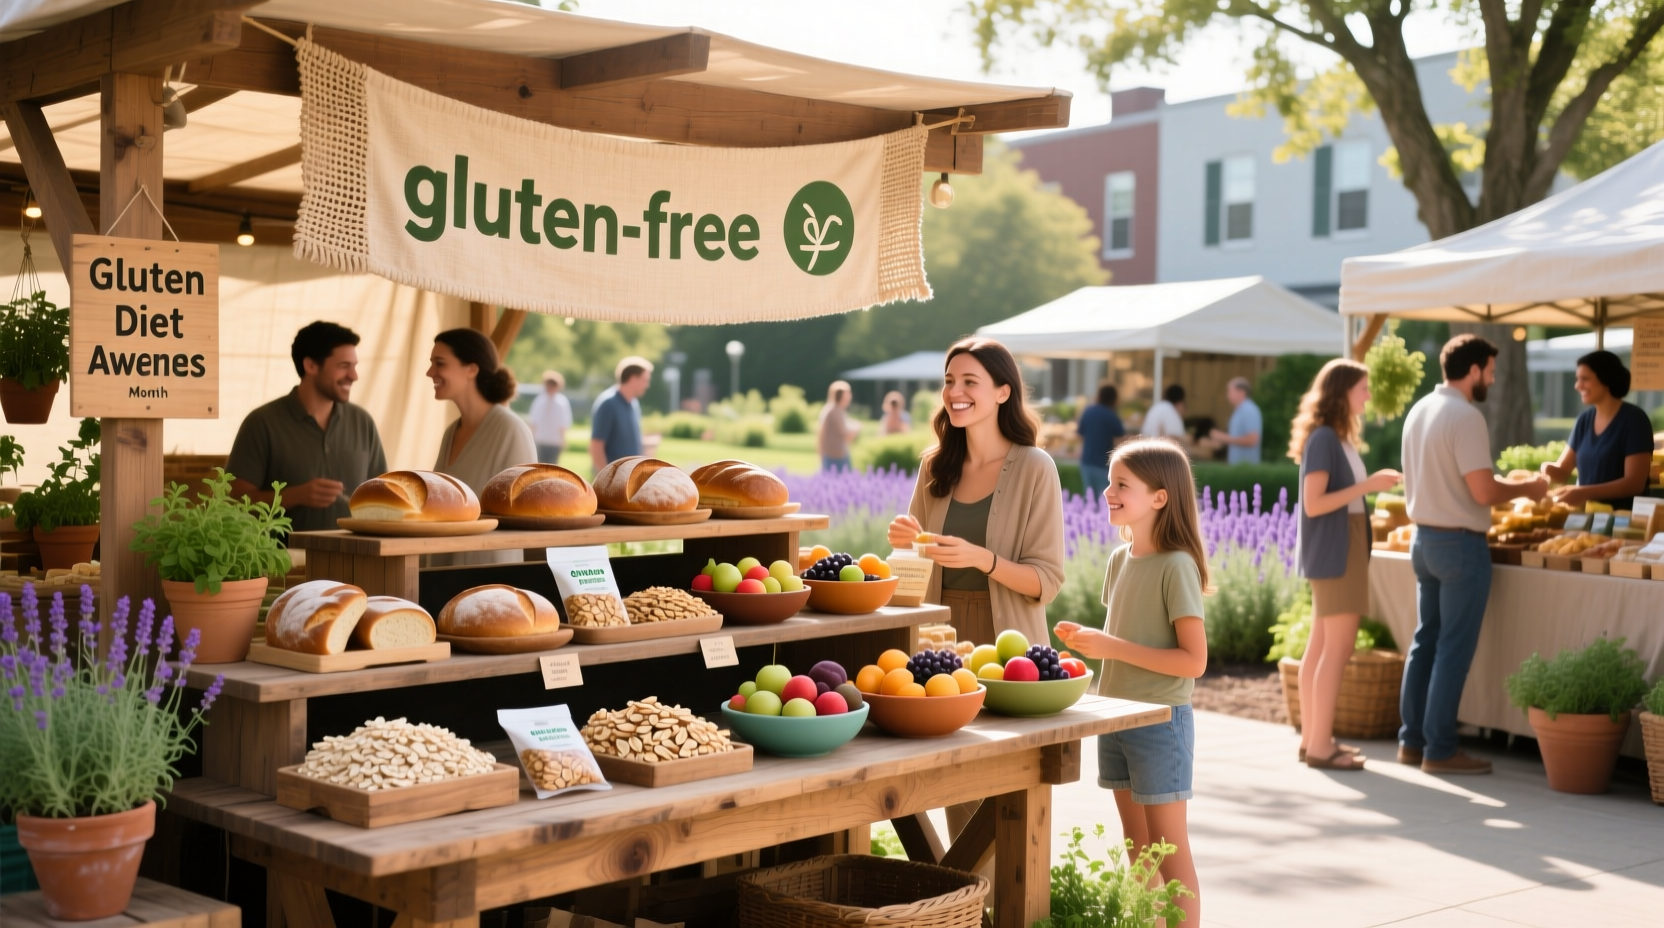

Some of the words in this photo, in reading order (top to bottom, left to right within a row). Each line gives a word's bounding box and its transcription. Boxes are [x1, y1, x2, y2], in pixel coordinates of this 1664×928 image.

[404, 154, 760, 262] gluten-free
[89, 256, 205, 296] Gluten
[115, 304, 184, 339] Diet
[87, 345, 206, 378] Awenes
